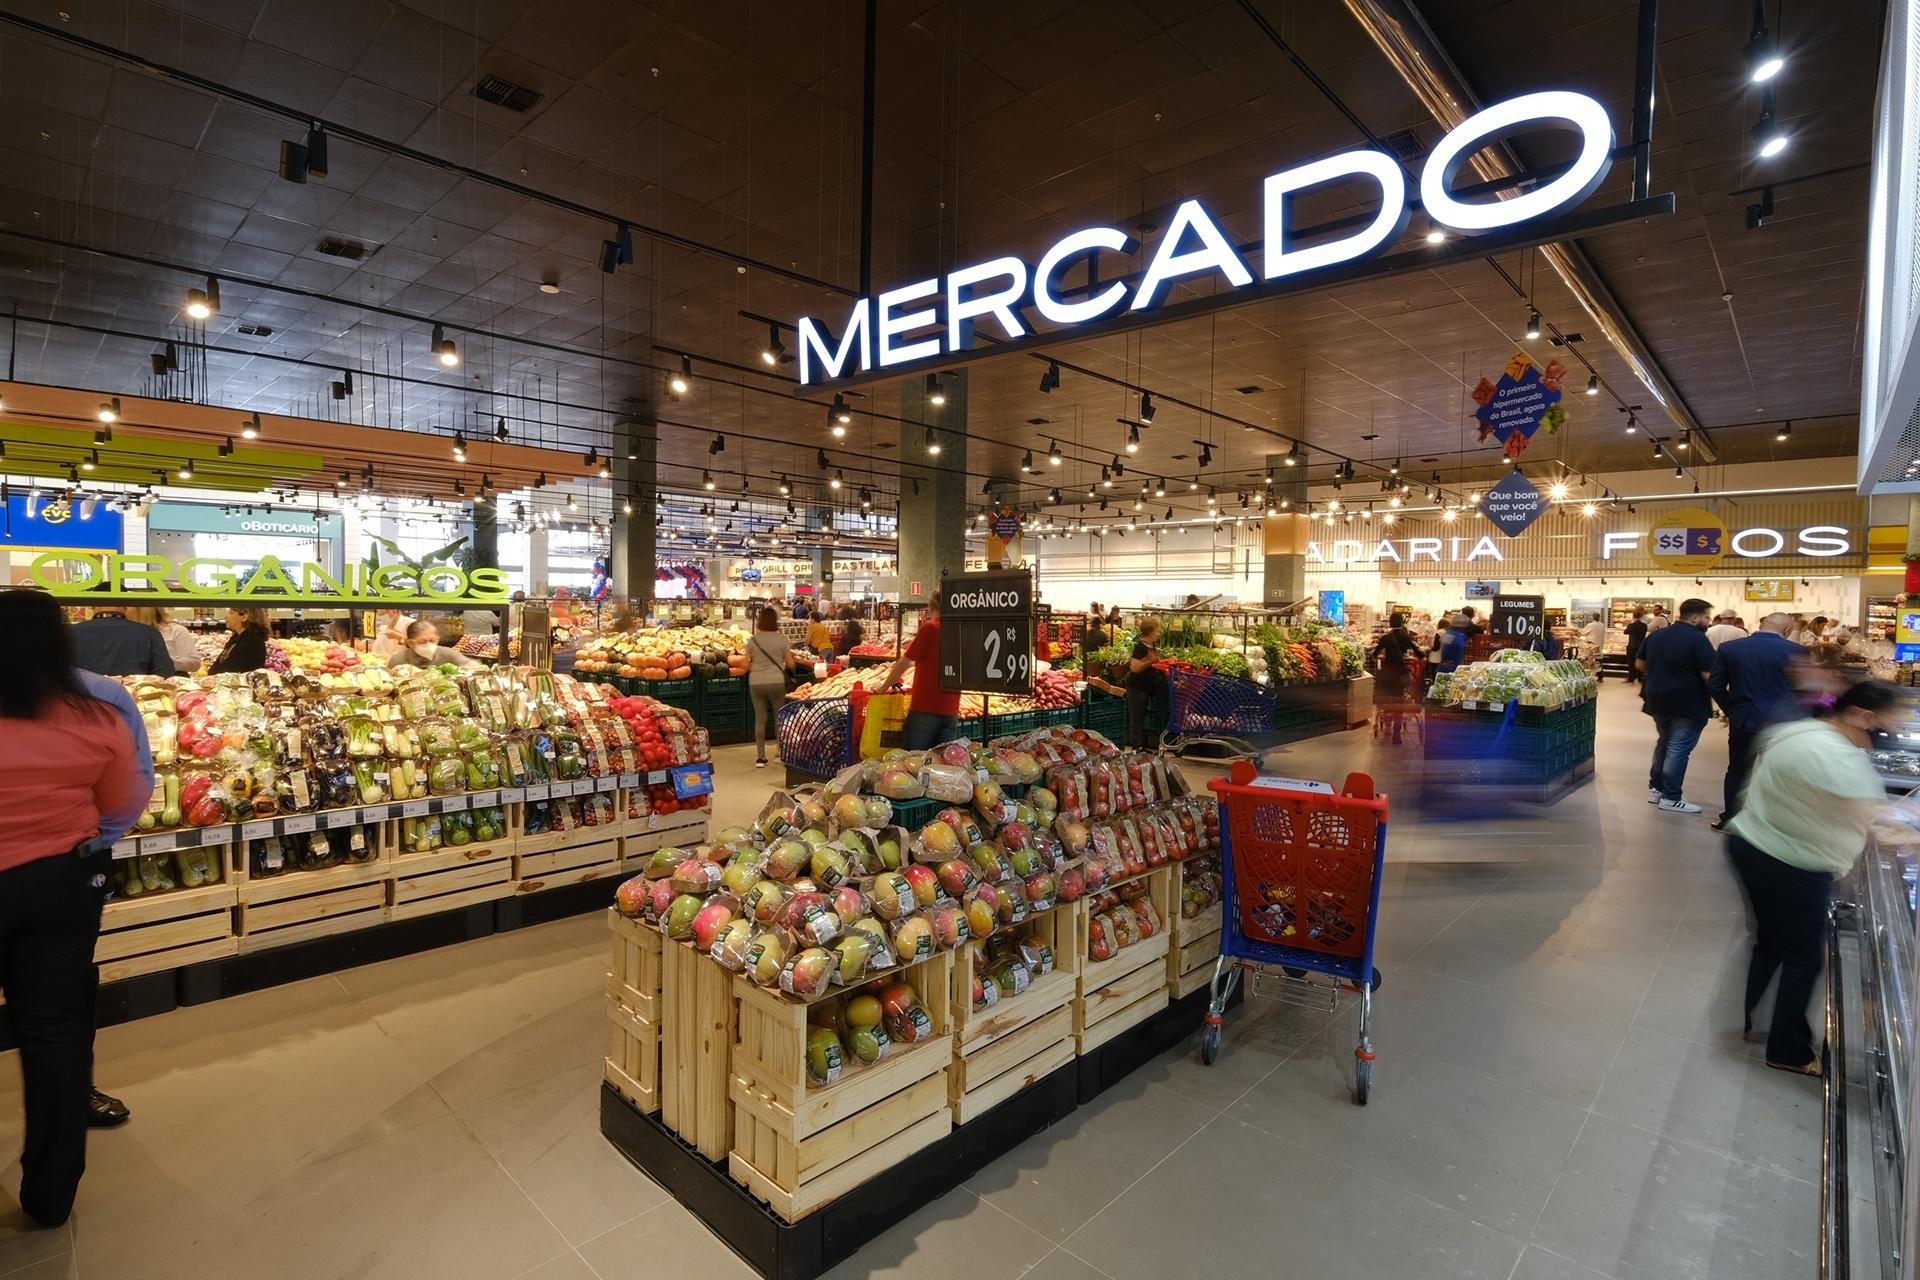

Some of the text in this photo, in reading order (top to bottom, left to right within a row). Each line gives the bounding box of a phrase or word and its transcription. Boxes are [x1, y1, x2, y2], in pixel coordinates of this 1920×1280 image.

[797, 90, 1615, 386] MERCADO
[1499, 383, 1537, 397] O primeiro
[1493, 393, 1543, 408] hipermercado
[1501, 407, 1523, 418] Brasil,
[1524, 403, 1546, 414] agora
[1489, 491, 1538, 500] Que bom
[1489, 501, 1538, 512] que você
[1500, 512, 1526, 521] veio!
[30, 551, 511, 599] ORGÂNICOS
[762, 564, 788, 573] GRILL
[950, 588, 1019, 609] ORGÂNICO
[1500, 600, 1535, 609] LEGUMES
[1006, 627, 1016, 642] R$
[944, 665, 956, 677] un.
